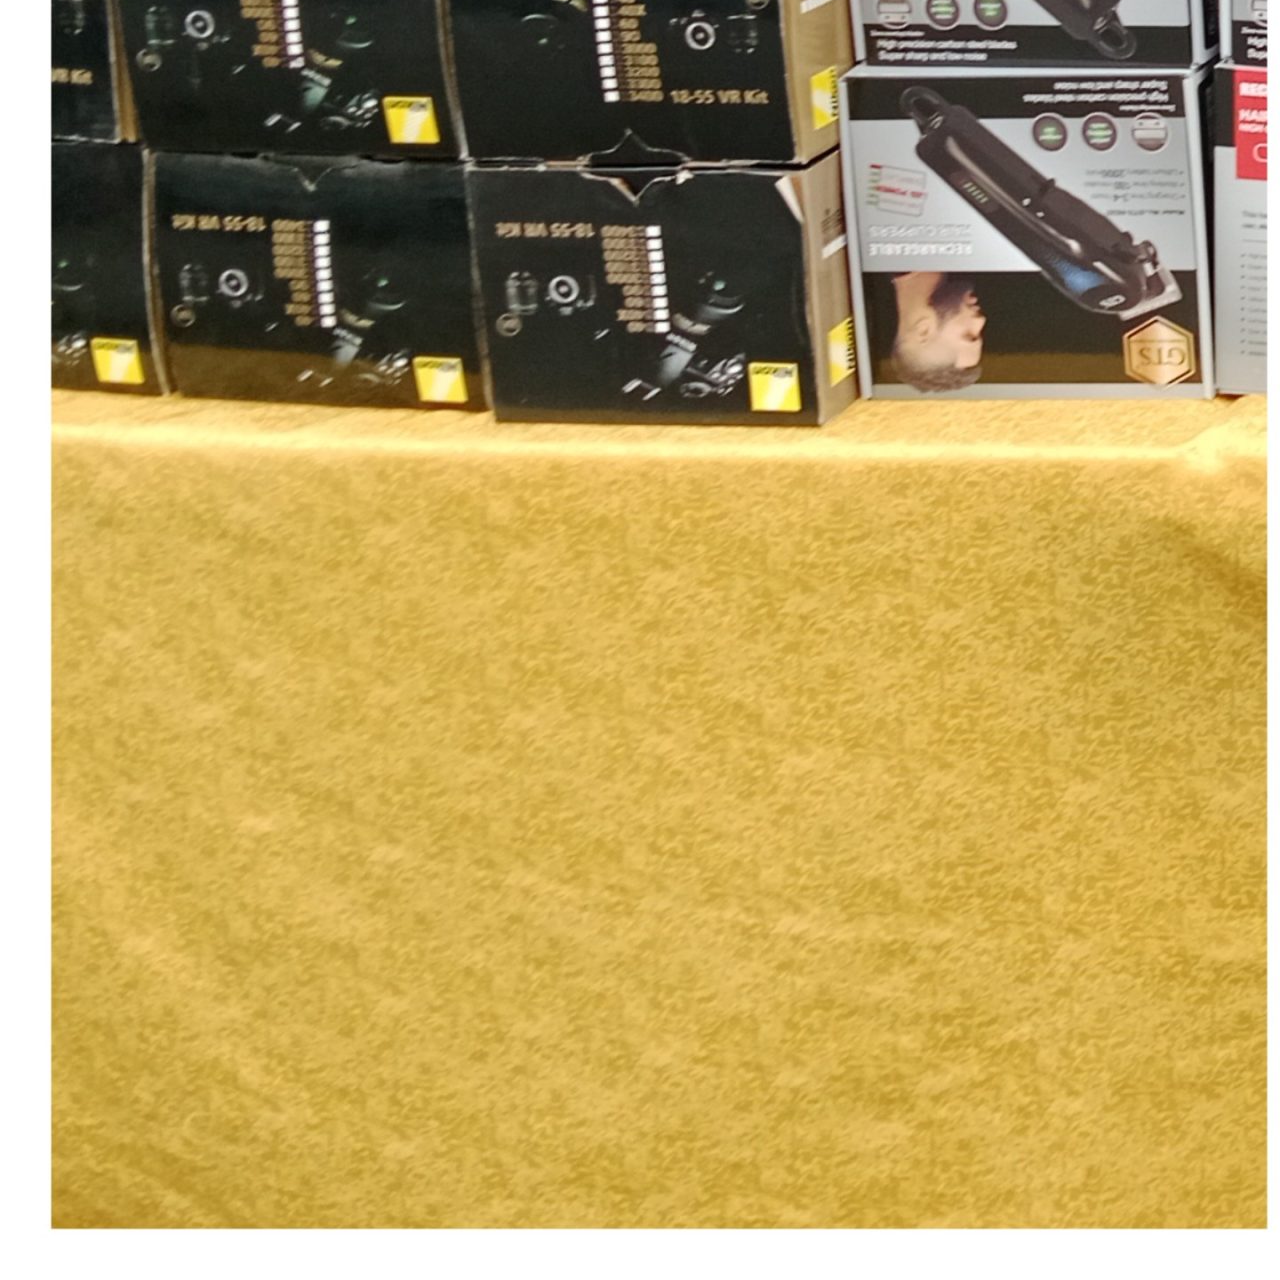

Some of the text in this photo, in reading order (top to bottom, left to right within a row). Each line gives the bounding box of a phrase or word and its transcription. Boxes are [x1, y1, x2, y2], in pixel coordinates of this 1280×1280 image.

[670, 89, 715, 104] 18-55
[717, 89, 742, 104] VR
[745, 89, 770, 104] Kit
[495, 222, 522, 238] Kit
[523, 222, 549, 237] VR
[550, 223, 596, 238] 18-55
[869, 242, 973, 256] RECHARGEABLE
[1138, 347, 1186, 369] GTS
